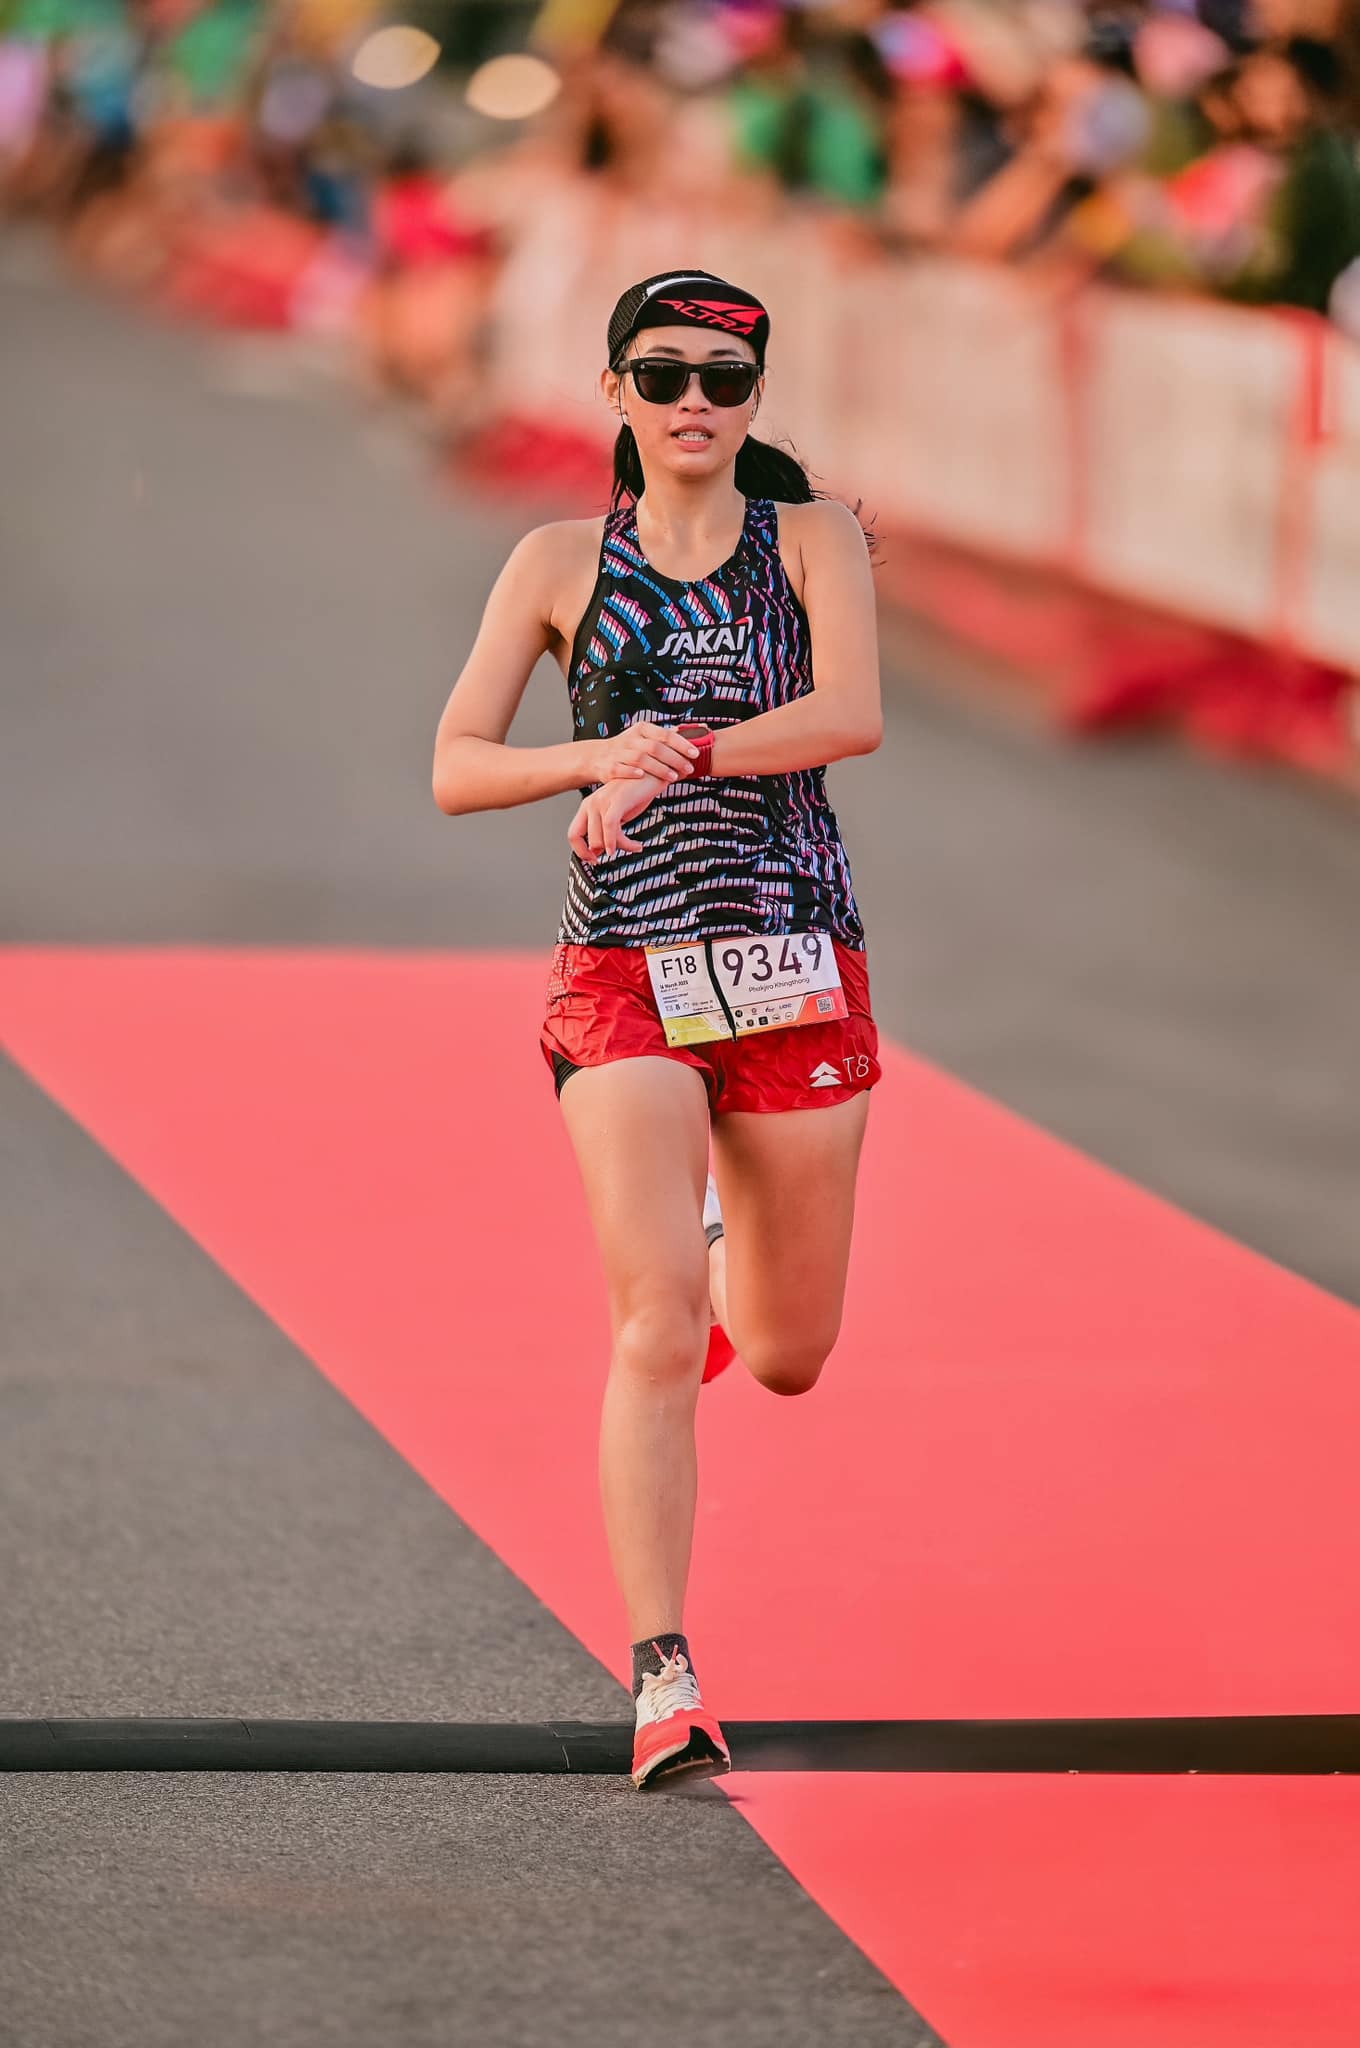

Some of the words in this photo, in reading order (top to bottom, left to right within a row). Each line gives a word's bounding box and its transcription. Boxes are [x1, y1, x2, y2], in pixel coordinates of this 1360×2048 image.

[656, 299, 755, 335] ALTRA
[656, 625, 747, 656] SAKAI
[661, 955, 697, 979] F18
[722, 934, 822, 987] 9349
[842, 1054, 869, 1083] T8
